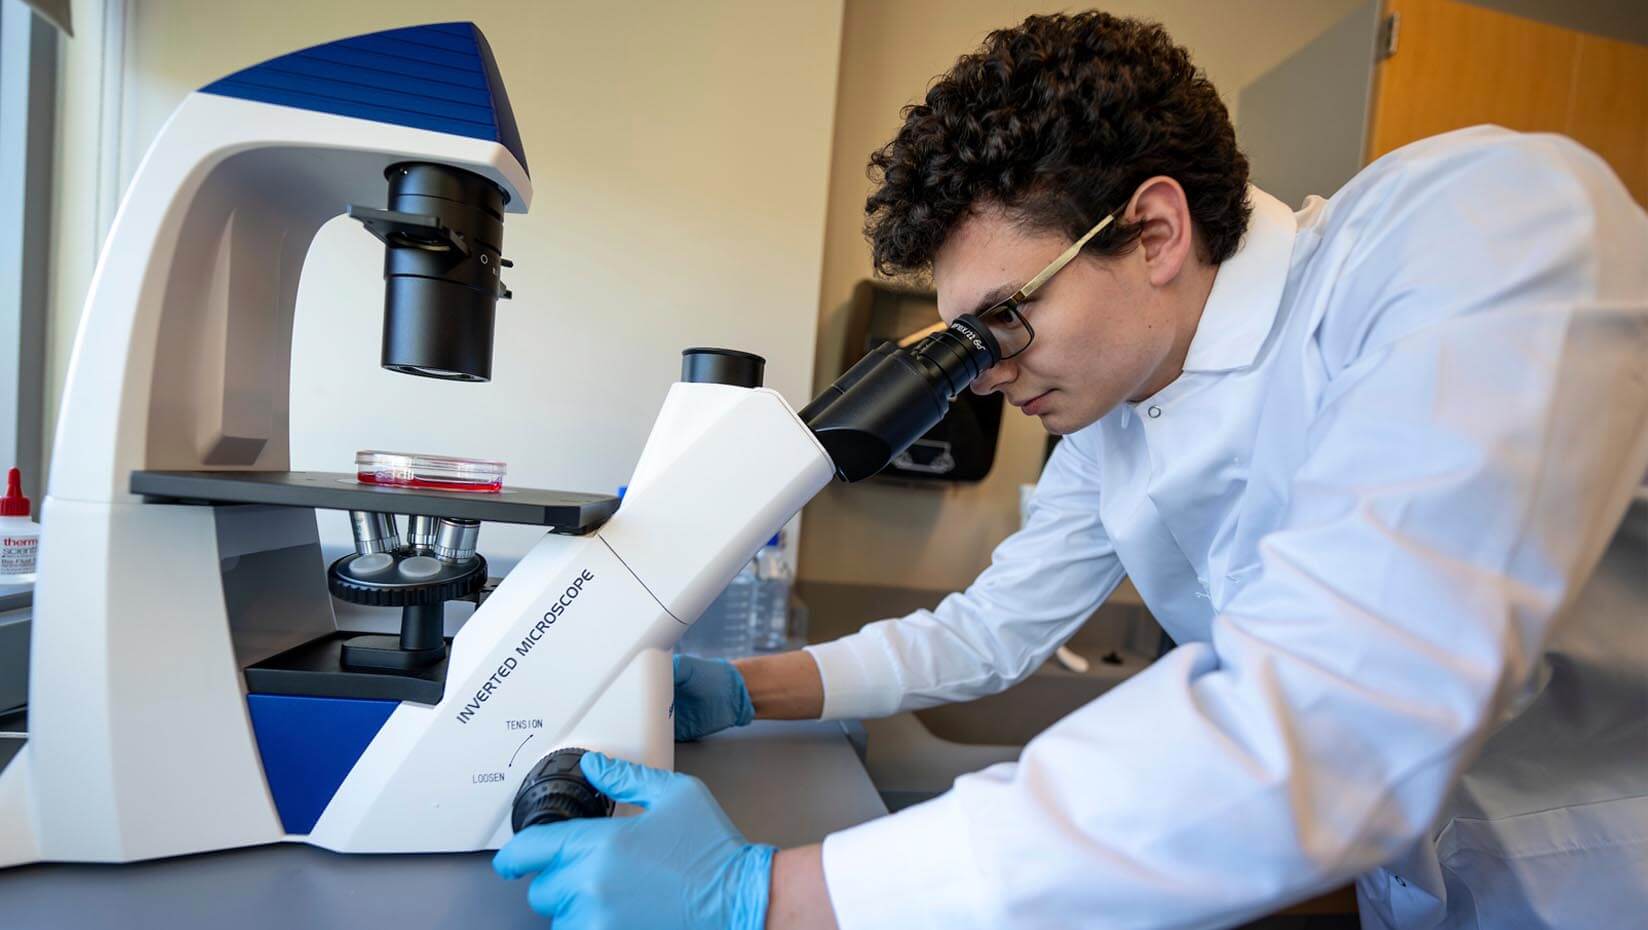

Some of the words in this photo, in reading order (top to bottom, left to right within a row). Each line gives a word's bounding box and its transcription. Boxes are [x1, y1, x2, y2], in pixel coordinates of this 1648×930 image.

[4, 538, 38, 547] therm
[456, 657, 518, 725] INVERTED
[515, 568, 595, 657] MICROSCOPE
[506, 719, 543, 730] TENSION
[472, 772, 505, 784] LOOSEN
